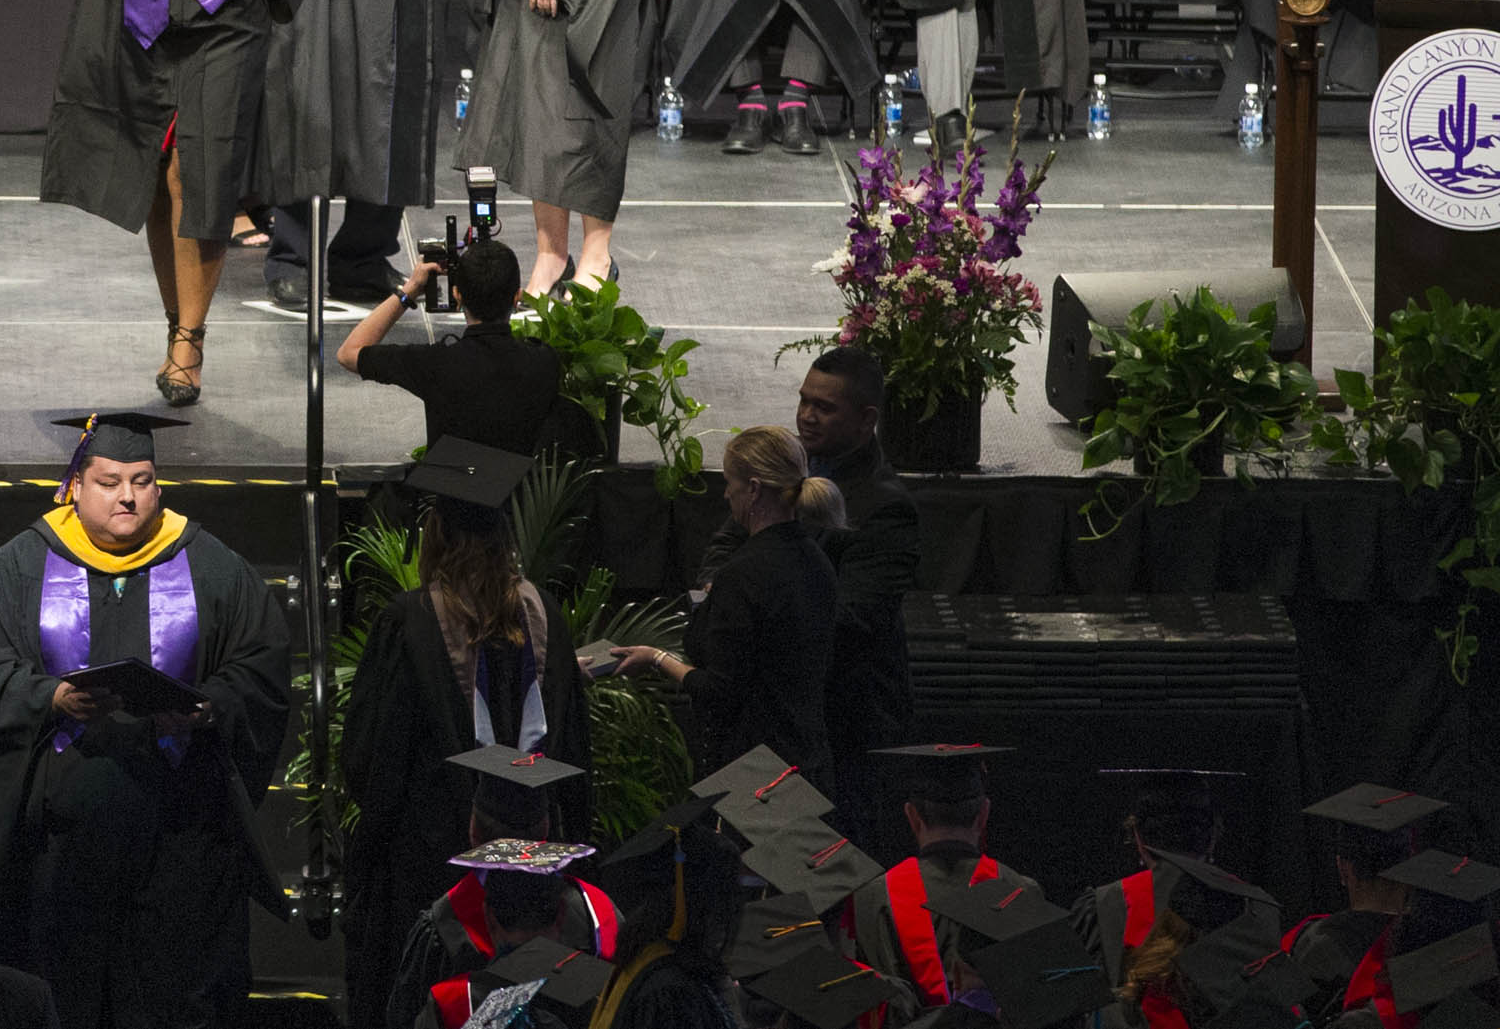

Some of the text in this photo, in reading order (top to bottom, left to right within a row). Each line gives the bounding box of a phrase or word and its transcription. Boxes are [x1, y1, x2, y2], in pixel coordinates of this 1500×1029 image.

[1380, 36, 1497, 154] GRAND CANYON
[1404, 183, 1491, 220] ARIZONA
